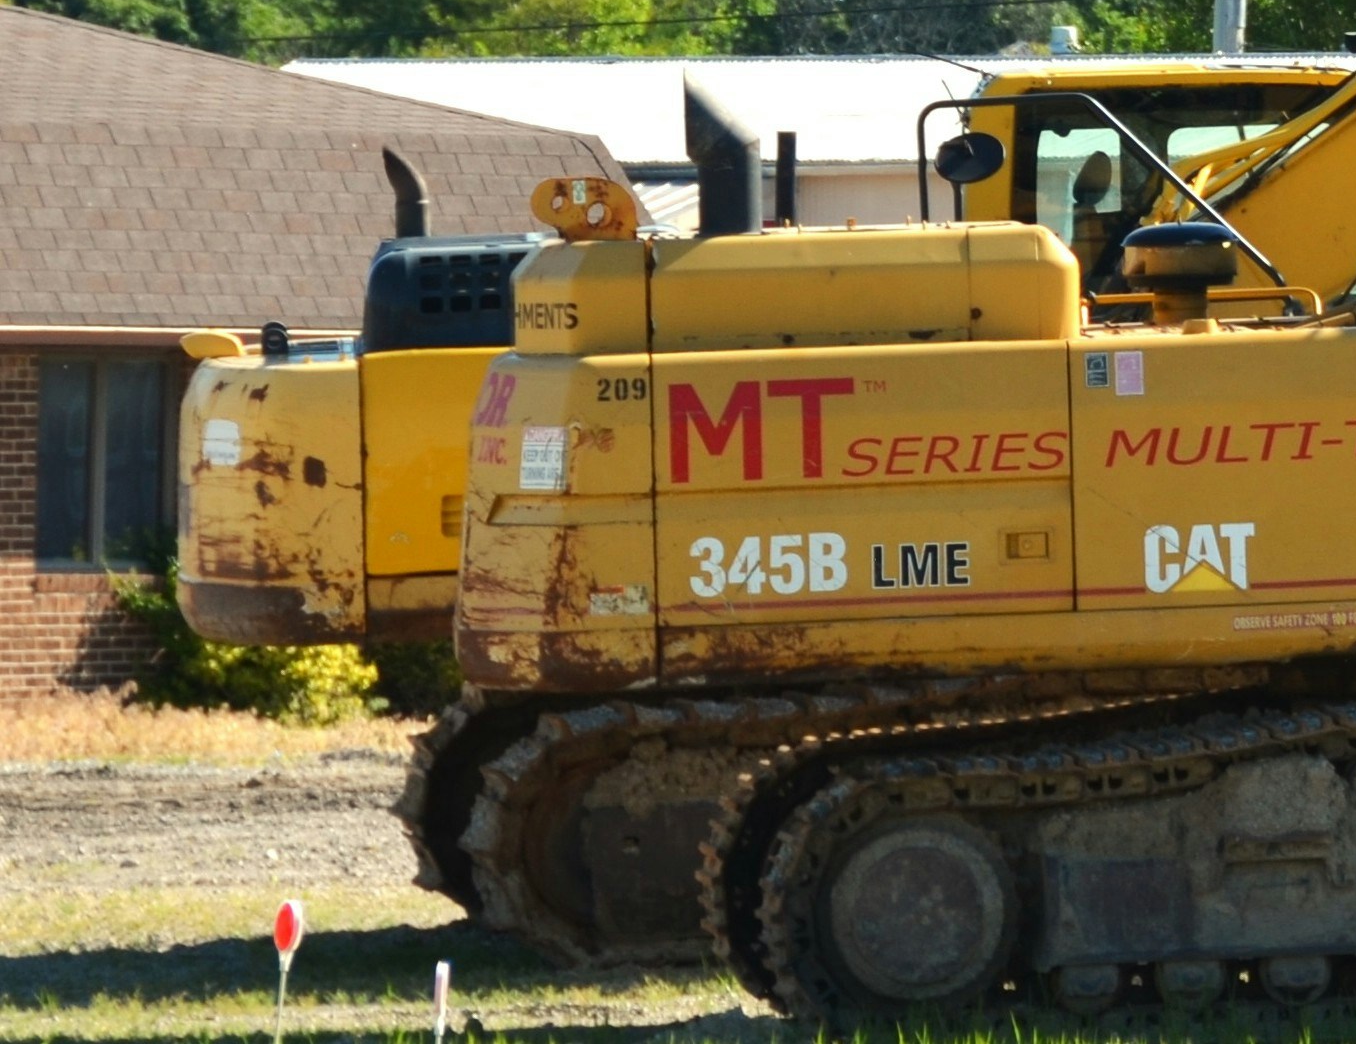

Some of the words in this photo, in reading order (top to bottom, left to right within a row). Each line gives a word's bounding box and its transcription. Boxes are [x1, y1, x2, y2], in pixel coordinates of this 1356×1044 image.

[596, 378, 648, 402] 209
[668, 377, 855, 483] MT
[841, 431, 1068, 477] SERIES
[688, 532, 847, 598] 345B
[871, 541, 970, 588] LME
[1143, 522, 1255, 593] CAT
[1234, 615, 1271, 629] OBSERVE
[1273, 614, 1302, 628] SAFETY
[1304, 613, 1328, 626] ZONE
